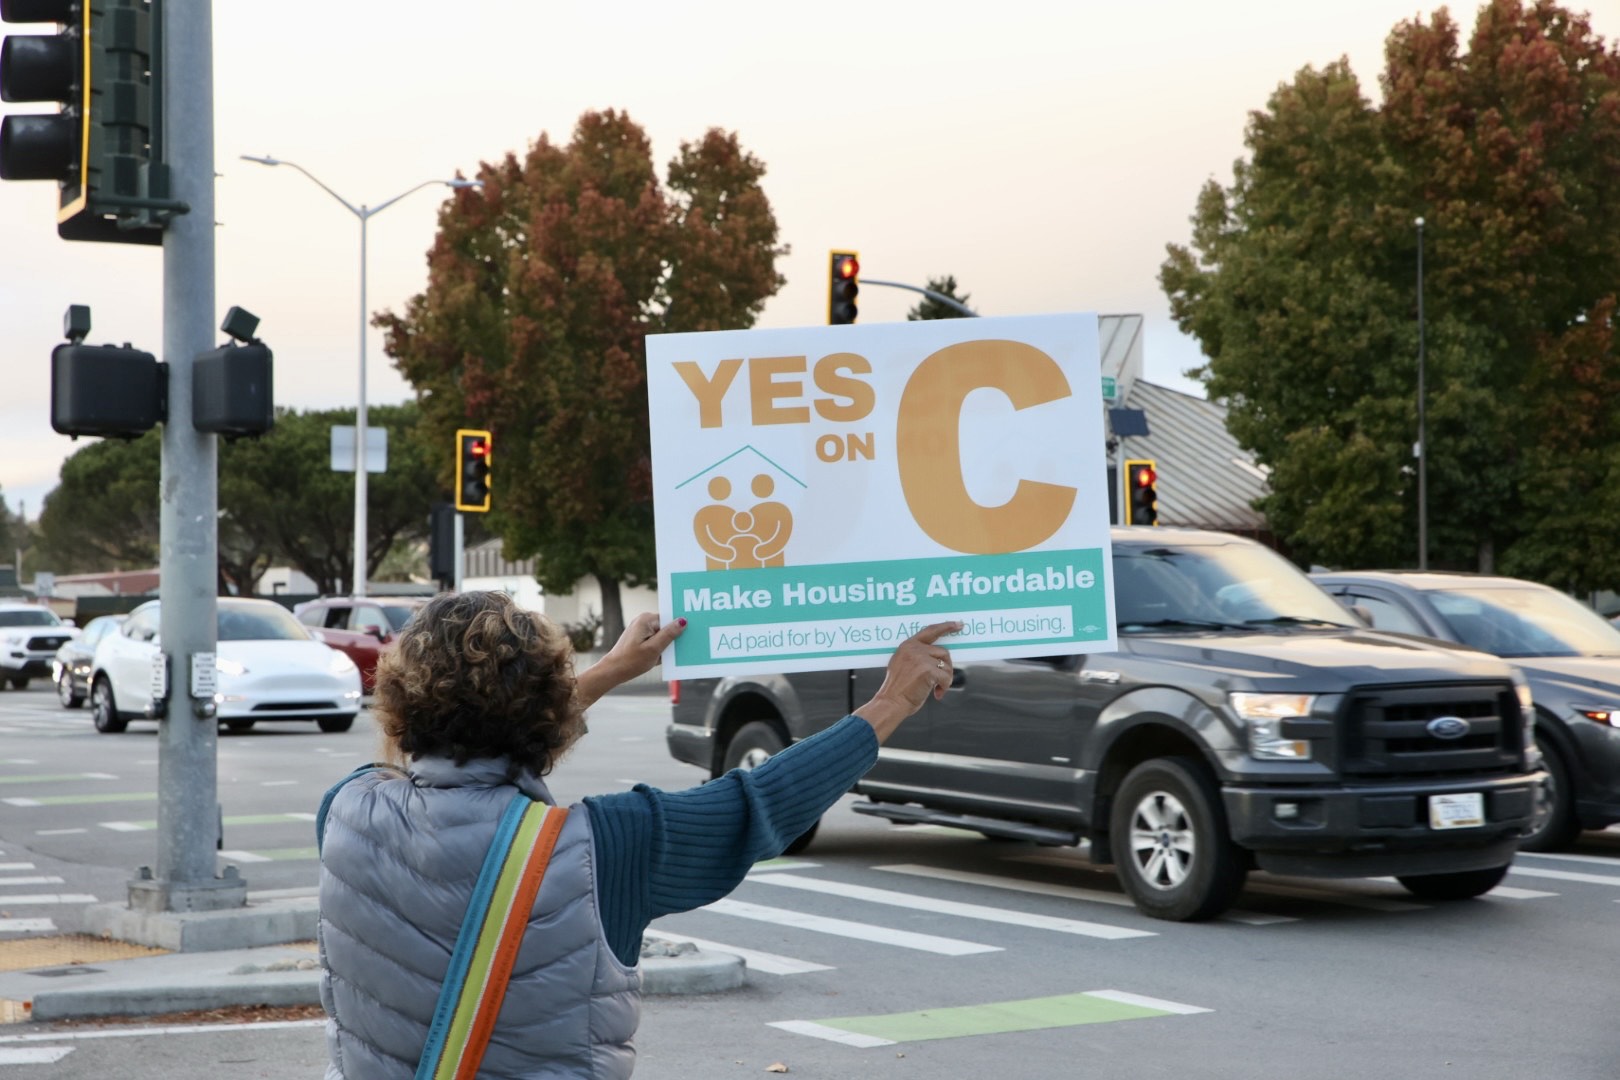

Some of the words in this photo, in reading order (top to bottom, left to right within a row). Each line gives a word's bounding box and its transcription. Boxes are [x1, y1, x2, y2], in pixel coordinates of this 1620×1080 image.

[671, 352, 876, 429] YES
[815, 432, 875, 463] ON
[896, 339, 1078, 554] C
[683, 583, 772, 613] Make
[783, 576, 917, 606] Housing
[927, 565, 1095, 598] Affordable
[717, 632, 742, 651] Ad
[746, 629, 784, 652] paid
[787, 628, 811, 647] for
[815, 628, 836, 648] by
[840, 625, 871, 643] Yes
[875, 624, 893, 641] to
[896, 618, 986, 640] Affble
[990, 613, 1067, 635] Housing.
